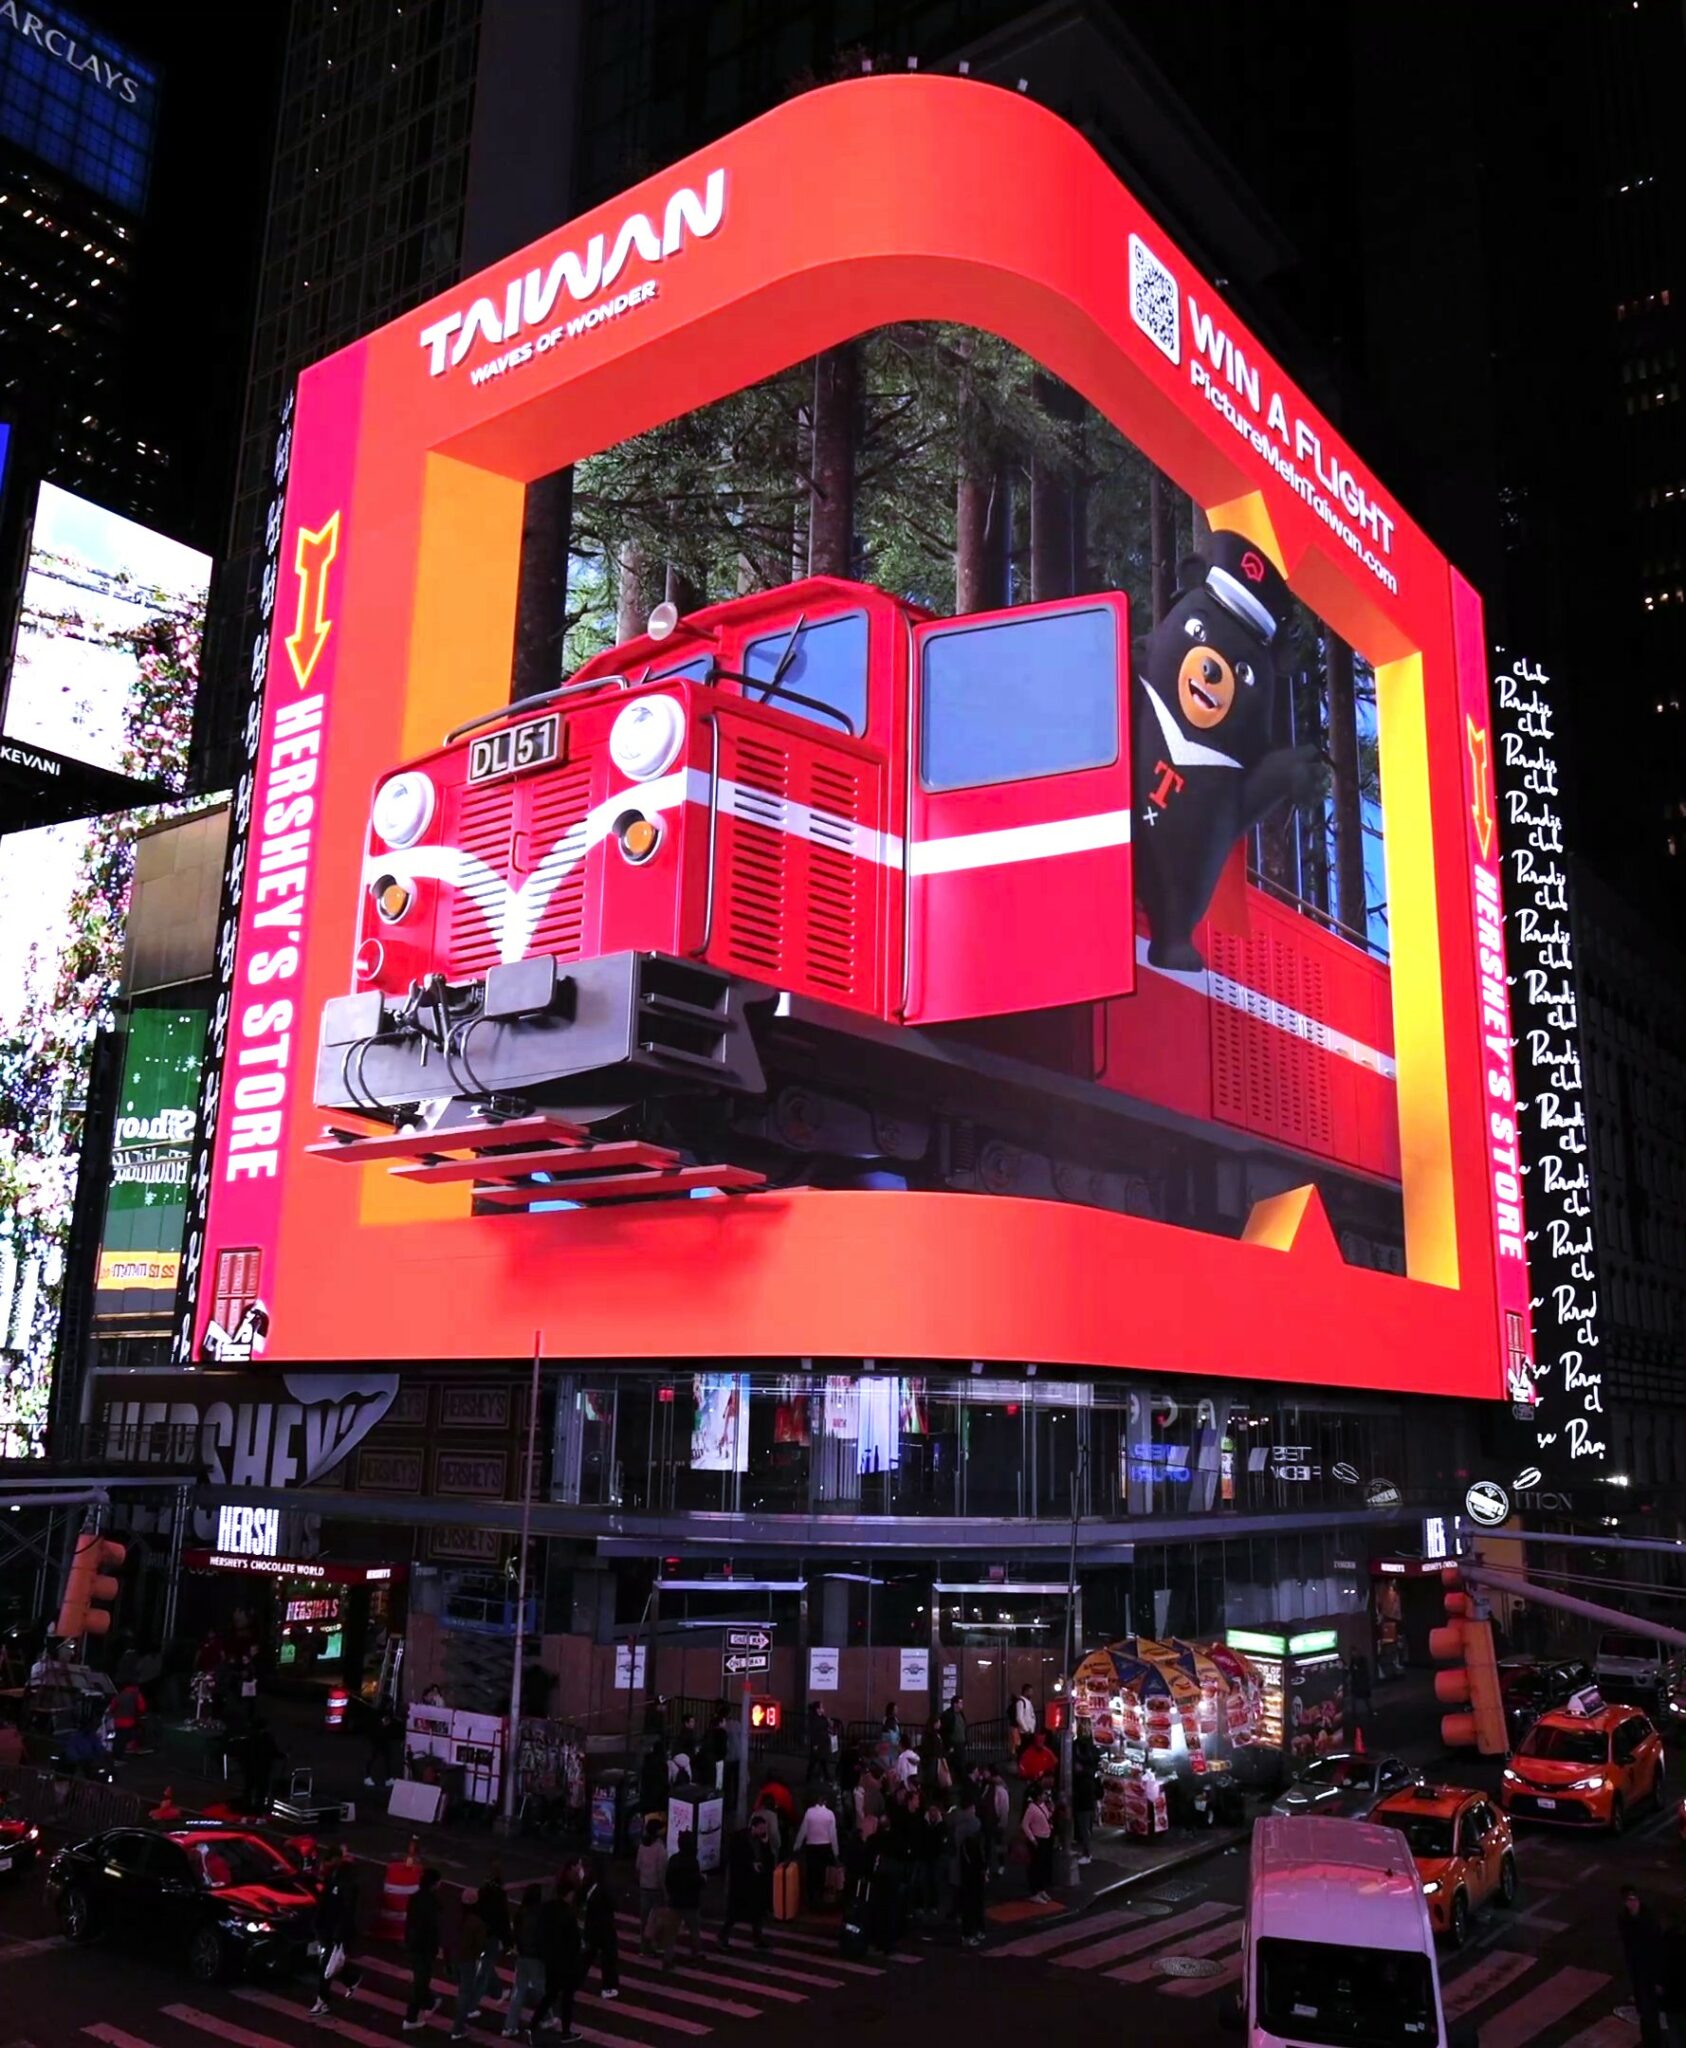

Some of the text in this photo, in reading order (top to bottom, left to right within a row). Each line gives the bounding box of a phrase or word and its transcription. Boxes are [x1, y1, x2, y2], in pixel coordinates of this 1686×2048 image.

[420, 168, 725, 377] TAIWAN
[471, 280, 657, 386] WAVES OF WONDER
[1189, 295, 1395, 554] WIN A FLIGHT
[1191, 359, 1398, 596] PictureMeInTaiwan.com
[1, 745, 61, 777] KEVANI
[247, 693, 325, 985] HERSHEY'S
[226, 999, 294, 1182] STORE
[1475, 864, 1523, 1260] HERSHEY'S STORE
[209, 1556, 248, 1570] HERSHEY'S
[250, 1559, 296, 1575] CHOCOLATE
[296, 1564, 325, 1578] WORLD
[217, 1505, 280, 1557] HERSH
[766, 1706, 777, 1726] 13
